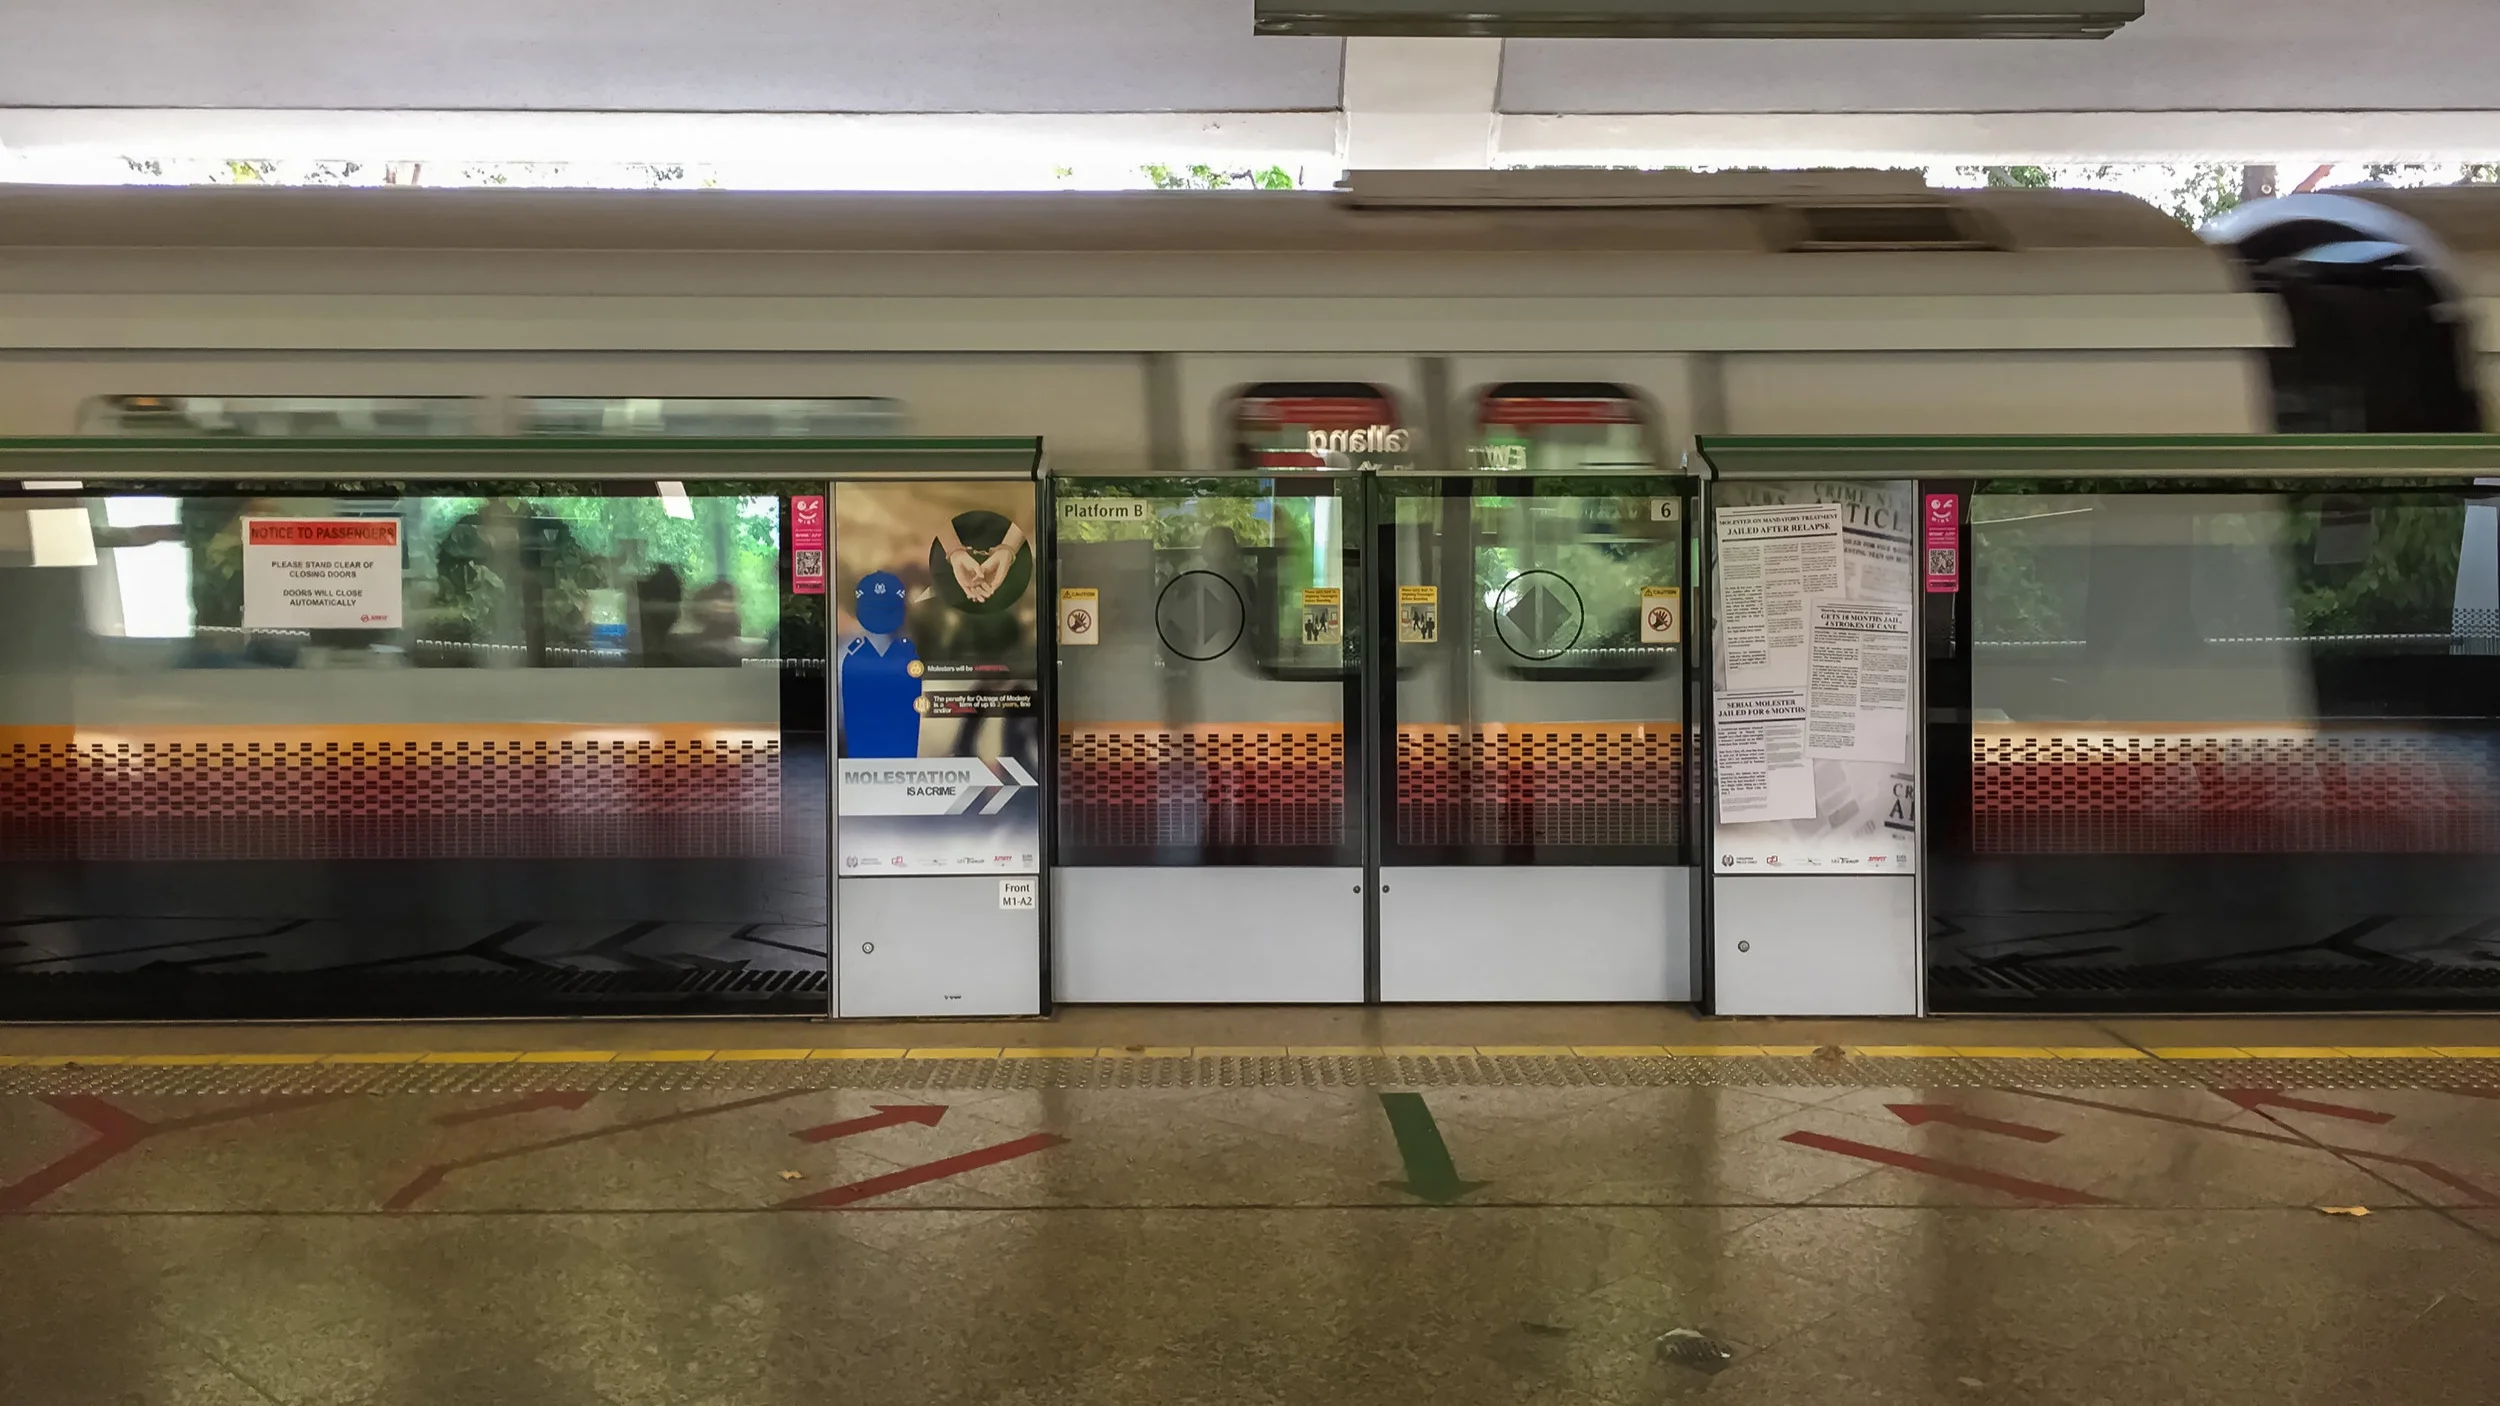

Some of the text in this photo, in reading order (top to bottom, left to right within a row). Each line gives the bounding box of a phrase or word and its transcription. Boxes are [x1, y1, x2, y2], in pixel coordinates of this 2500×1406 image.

[1065, 504, 1143, 518] Platform B
[1661, 502, 1671, 518] 6
[251, 527, 394, 539] NOTICE TO PASSENGERS
[1727, 522, 1831, 535] JAILED AFTER RELAPSE
[271, 561, 374, 569] PLEASE STAND CLEAR OF
[283, 589, 363, 597] DOORS WILL CLOSE
[1851, 614, 1883, 622] MONTHS
[1830, 621, 1864, 629] STROKES
[1006, 695, 1031, 703] Modesty
[1755, 699, 1796, 707] MOLESTER
[844, 771, 970, 785] MOLESTATION
[907, 786, 956, 796] IS A CRIME
[1005, 883, 1030, 893] Front
[1002, 897, 1032, 906] M1-A2
